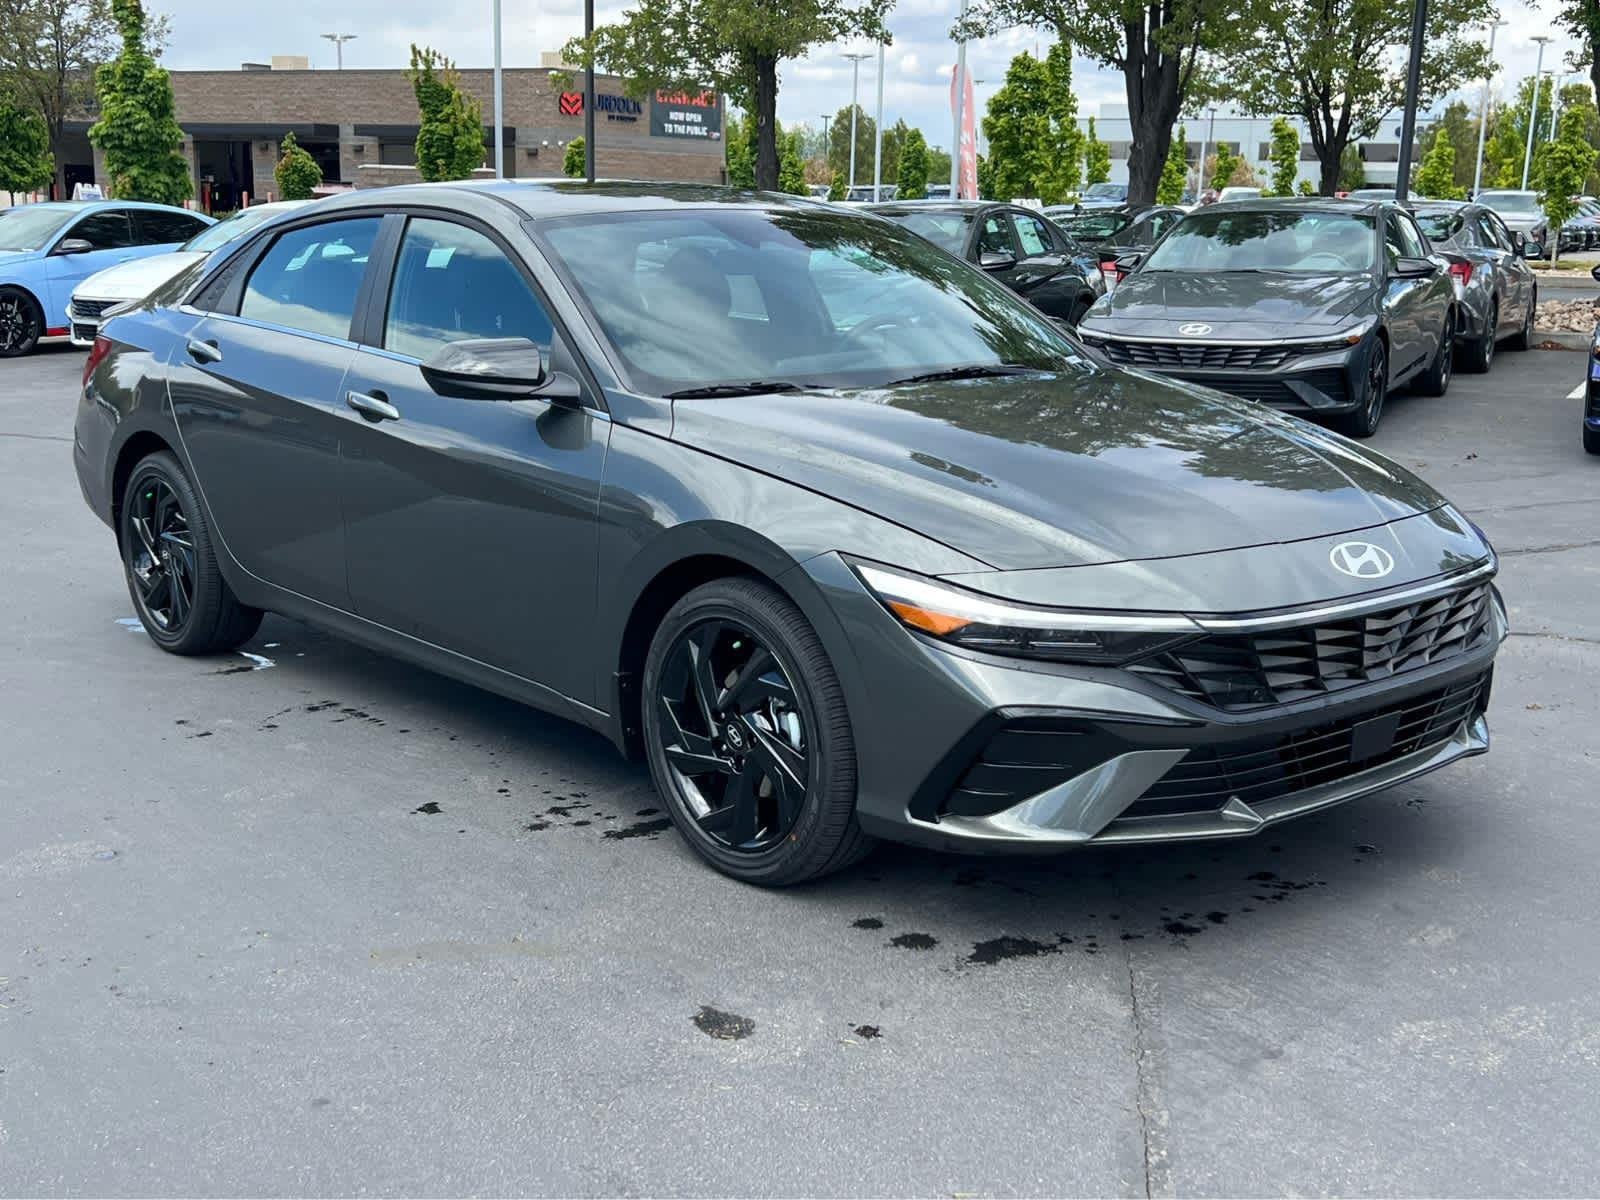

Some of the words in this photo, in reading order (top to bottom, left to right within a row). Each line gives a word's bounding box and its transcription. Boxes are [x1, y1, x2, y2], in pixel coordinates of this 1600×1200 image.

[669, 111, 685, 121] NOW
[686, 112, 702, 123] OPEN
[664, 123, 673, 133] TO
[674, 124, 685, 134] THE
[686, 125, 708, 136] PUBLIC
